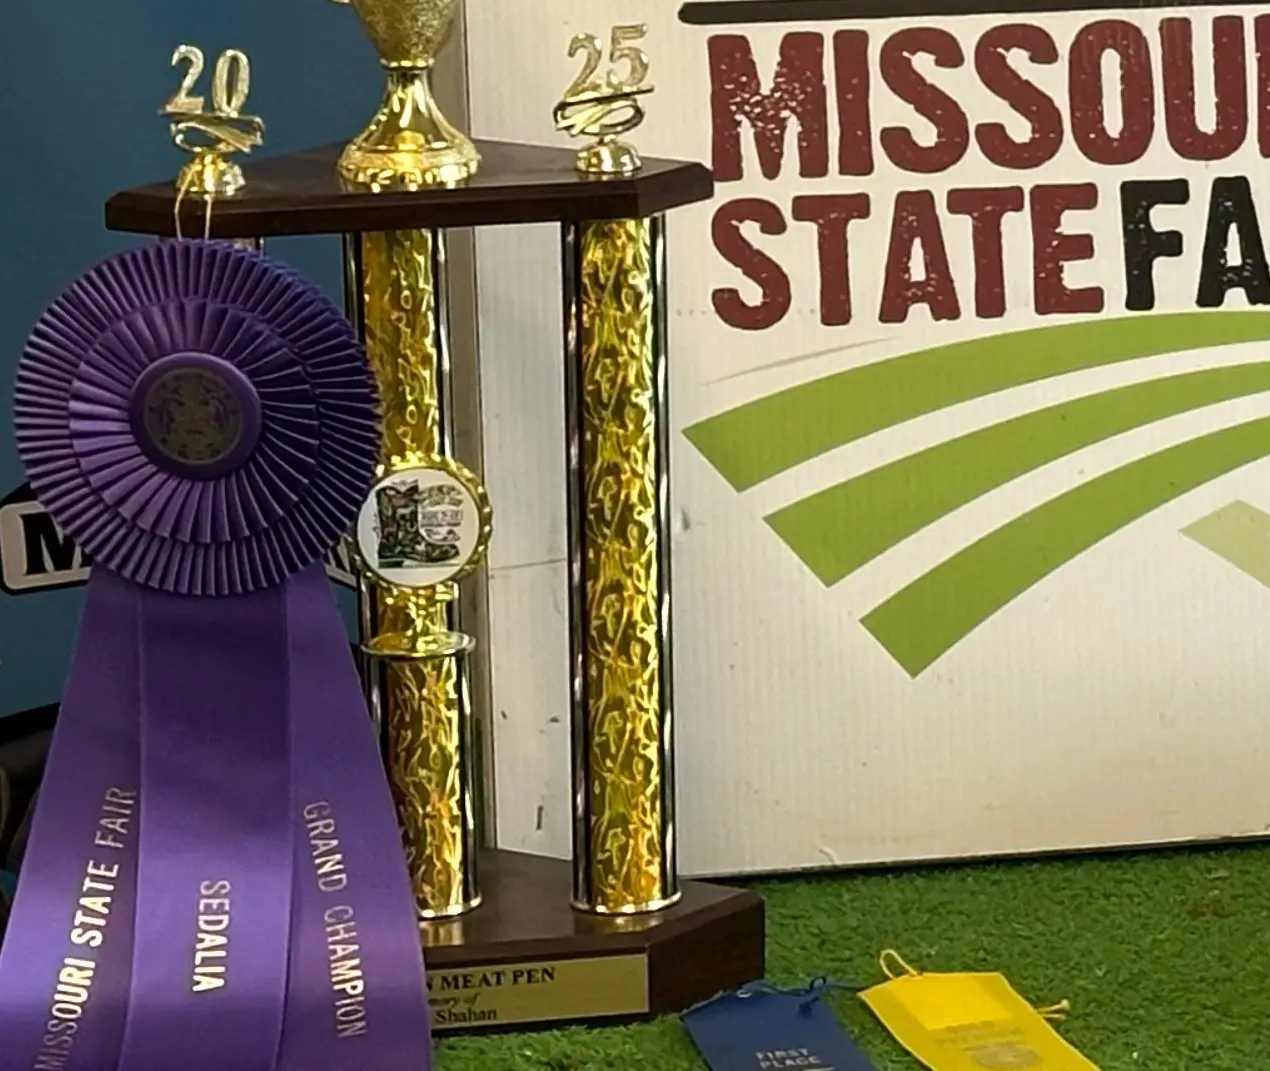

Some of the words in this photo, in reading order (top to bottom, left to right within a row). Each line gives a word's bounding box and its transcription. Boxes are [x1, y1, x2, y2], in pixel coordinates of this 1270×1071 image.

[166, 44, 250, 118] 20
[563, 23, 649, 98] 25
[303, 802, 348, 892] GRAND
[33, 957, 96, 1071] MISSOURI
[71, 859, 119, 947] STATE
[95, 787, 137, 848] FAIR
[192, 879, 231, 993] SEDALIA
[324, 906, 367, 1038] CHAMPION
[441, 970, 506, 991] MEAT
[512, 965, 556, 986] PEN
[755, 1047, 808, 1060] FIRST
[760, 1056, 823, 1069] PLACE
